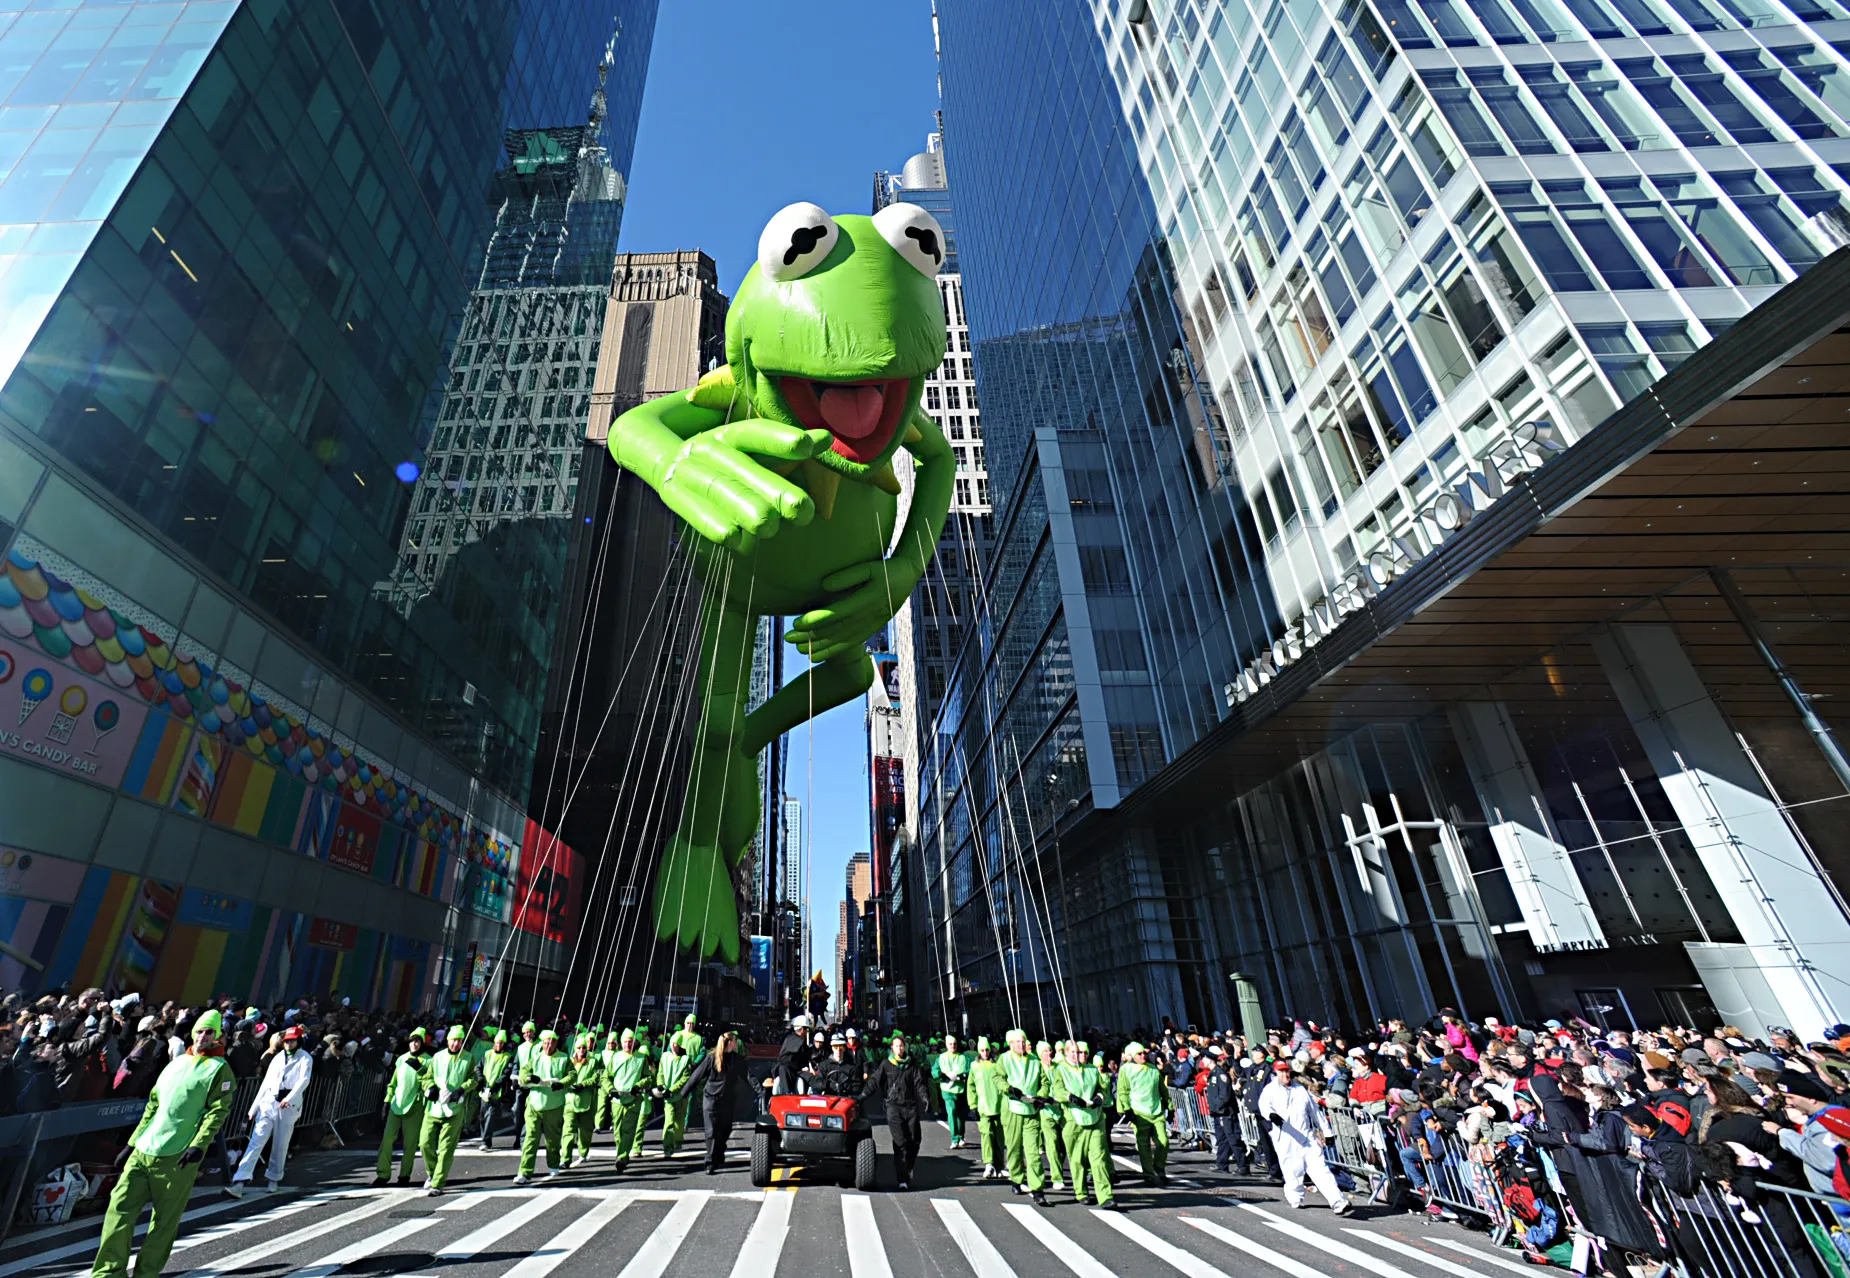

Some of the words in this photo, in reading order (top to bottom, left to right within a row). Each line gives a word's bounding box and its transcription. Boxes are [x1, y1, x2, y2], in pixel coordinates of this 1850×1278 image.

[1223, 651, 1278, 708] BANK
[1272, 627, 1303, 667] OF
[1411, 421, 1566, 546] TOWER
[22, 739, 72, 765] CANDY
[71, 757, 98, 776] BAR
[1562, 939, 1609, 952] BRYAN
[96, 1104, 120, 1117] POLICE
